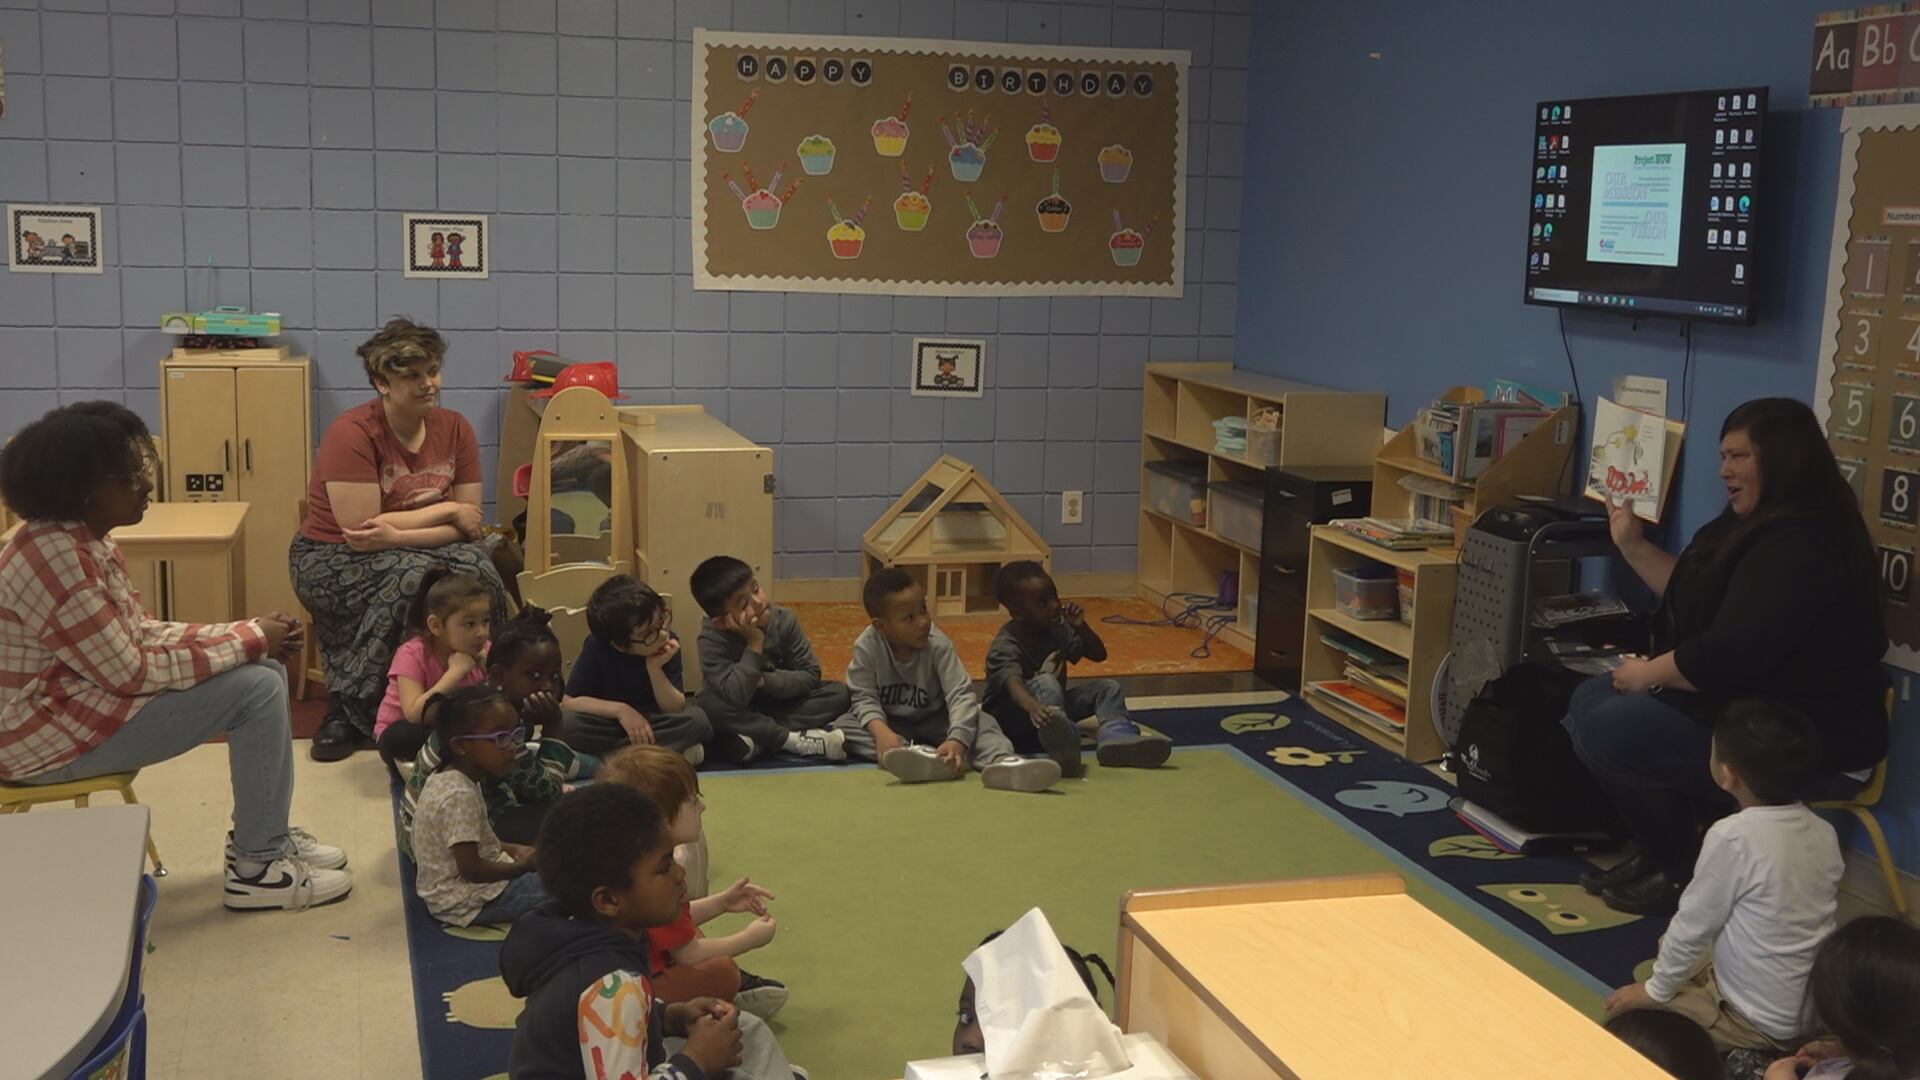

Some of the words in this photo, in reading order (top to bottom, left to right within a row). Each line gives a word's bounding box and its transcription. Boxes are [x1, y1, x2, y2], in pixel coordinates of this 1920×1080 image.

[1815, 29, 1850, 72] Aa
[1862, 23, 1897, 68] Bb
[742, 61, 866, 81] HAPPY
[953, 71, 1148, 93] BIRTHDAY
[1854, 319, 1870, 355] 3
[1846, 389, 1864, 426] 5
[1899, 400, 1916, 439] 6
[1891, 474, 1909, 513] 8
[1882, 551, 1908, 591] 10
[879, 683, 929, 708] HICAG
